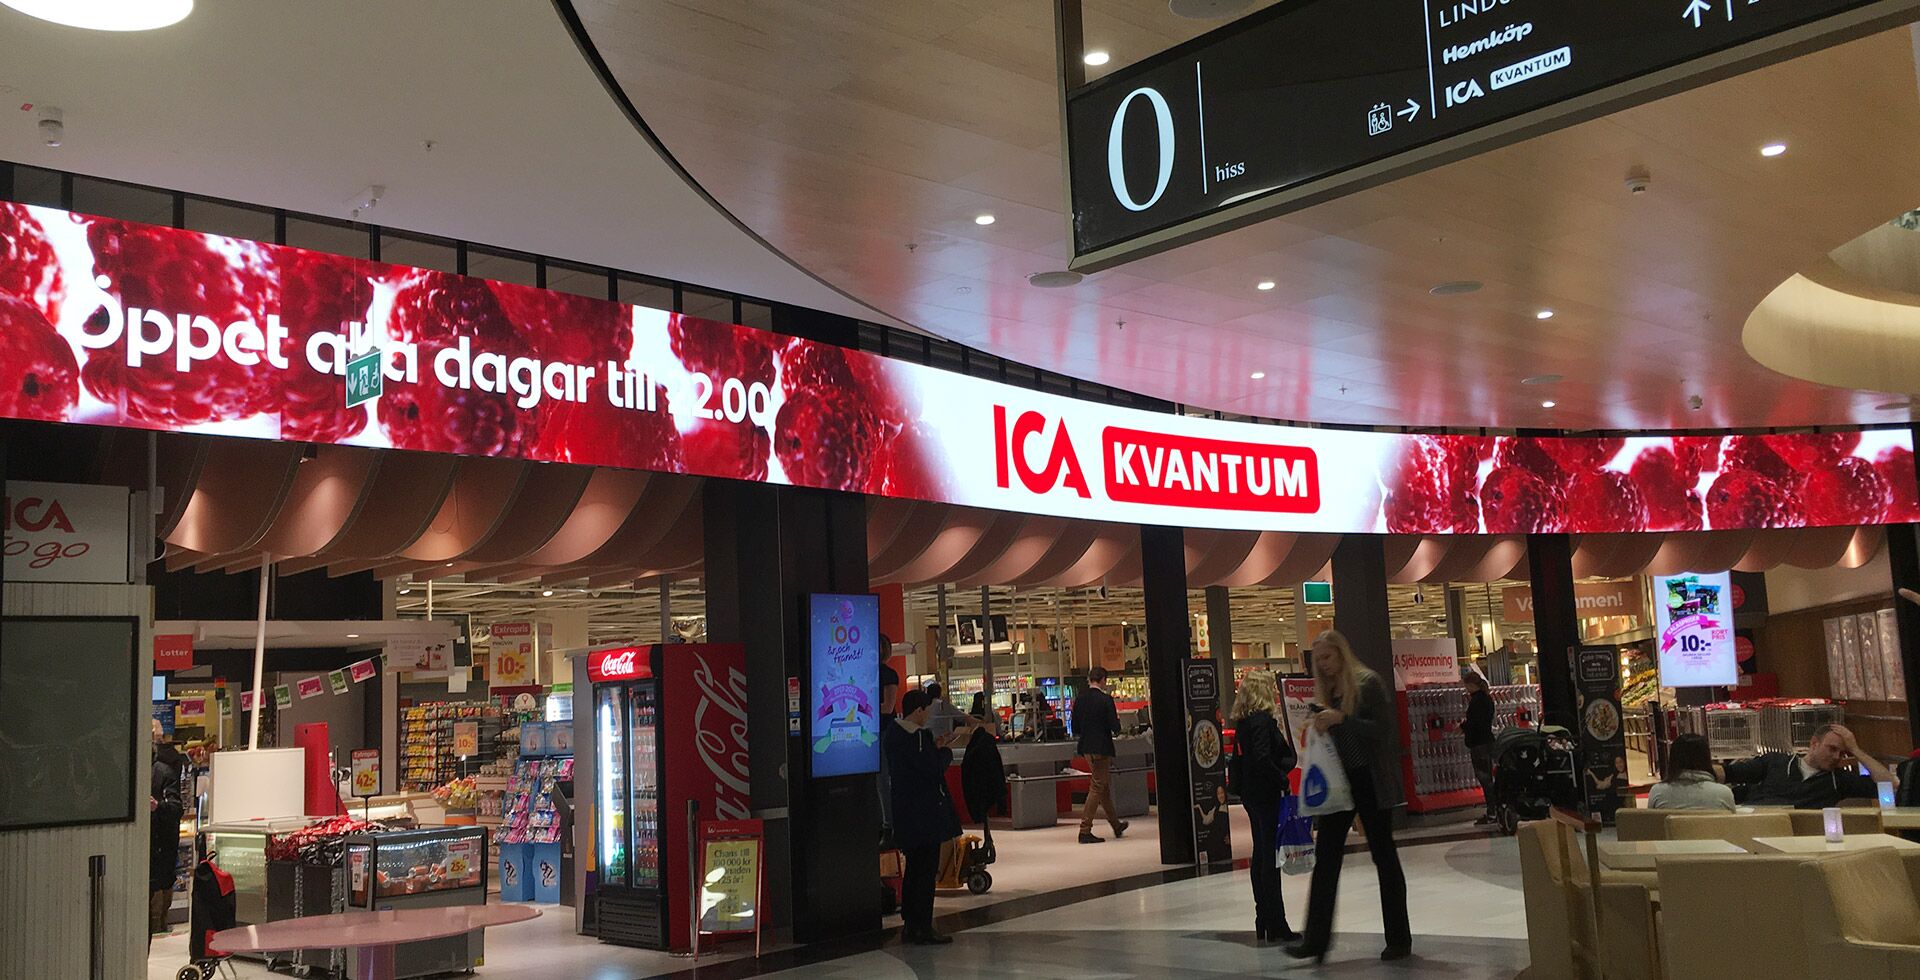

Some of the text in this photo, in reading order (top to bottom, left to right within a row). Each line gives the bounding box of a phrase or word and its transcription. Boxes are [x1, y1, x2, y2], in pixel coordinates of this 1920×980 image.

[1440, 0, 1514, 27] LIND
[1443, 22, 1533, 65] Hemköp
[1445, 52, 1566, 108] ICA KVANTUM
[1215, 161, 1246, 182] hiss
[434, 336, 595, 409] dagar
[607, 359, 657, 413] till
[993, 404, 1309, 499] ICA KVANTUM
[4, 496, 76, 533] ICA
[4, 536, 90, 569] o go
[494, 624, 529, 634] Extrapris
[831, 625, 861, 645] 100
[160, 649, 189, 657] Lotter
[1680, 634, 1711, 652] 10:-
[497, 655, 526, 676] 10:-
[601, 651, 637, 677] Coca-Cola
[1401, 654, 1453, 670] Självscanning
